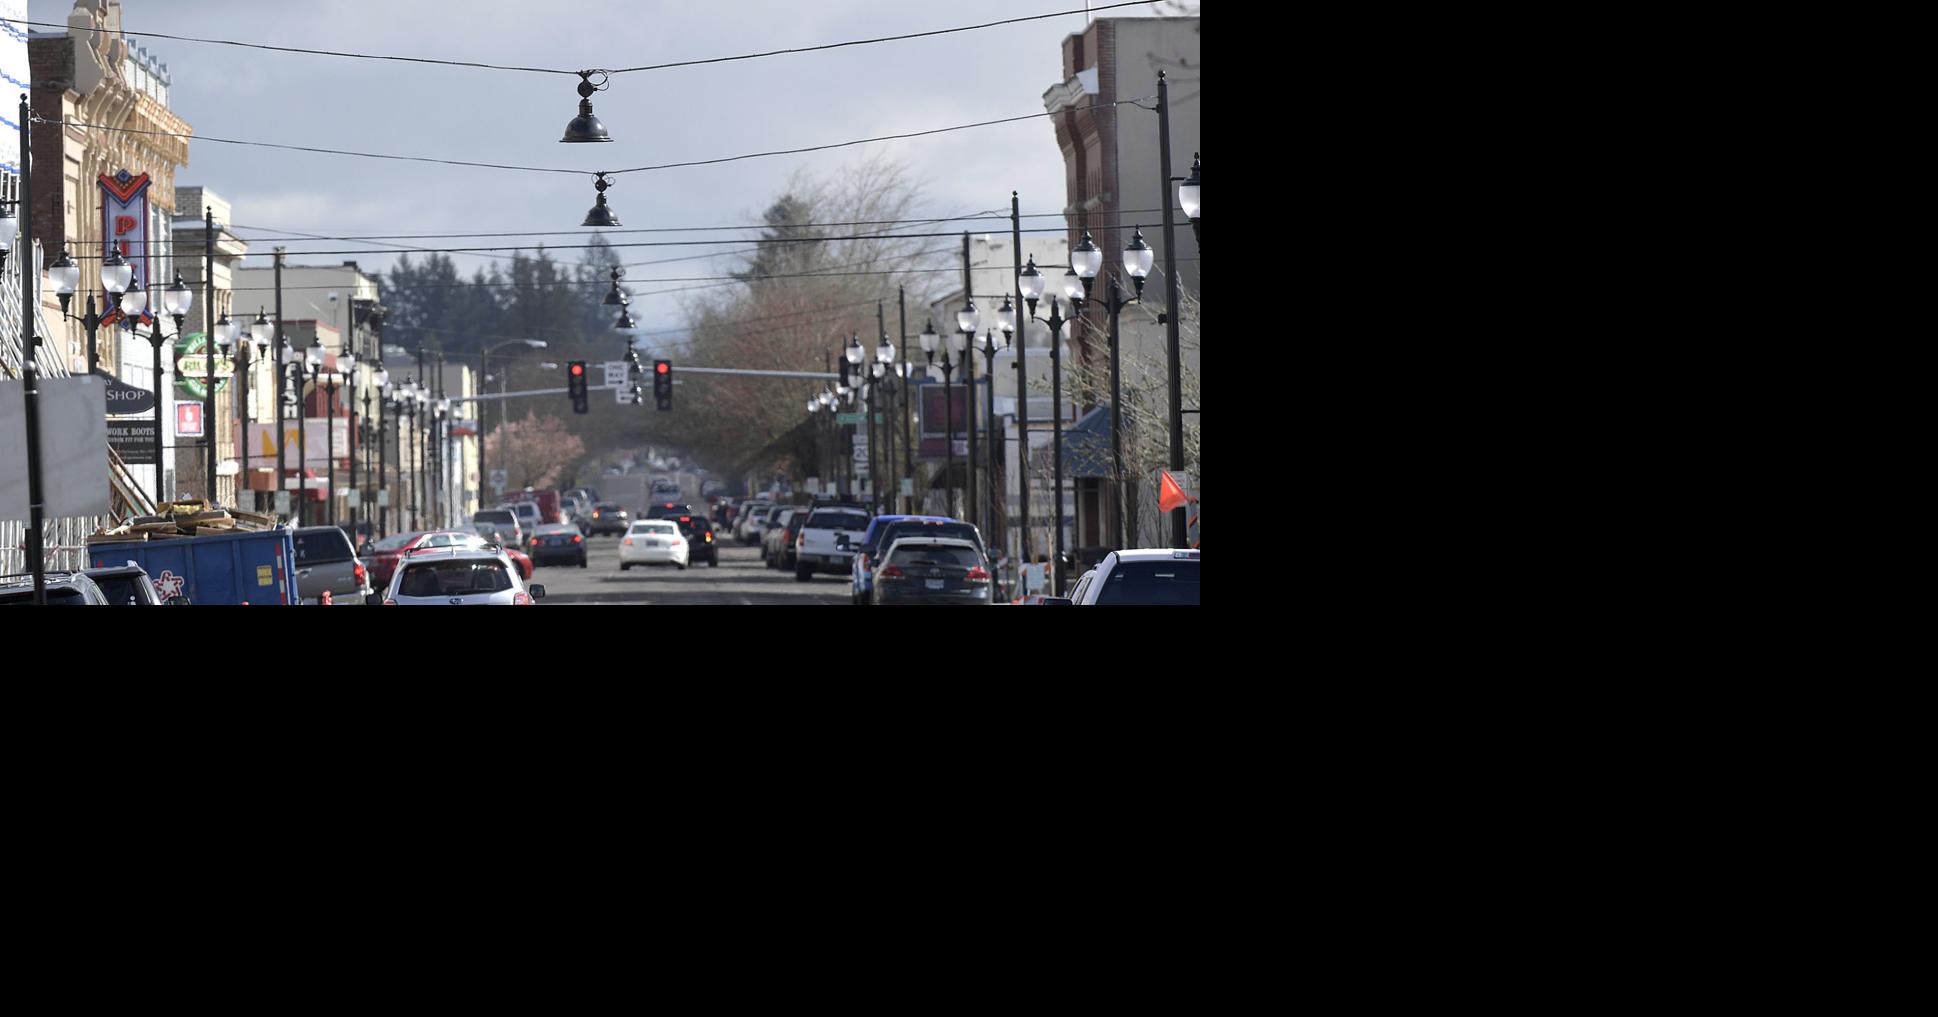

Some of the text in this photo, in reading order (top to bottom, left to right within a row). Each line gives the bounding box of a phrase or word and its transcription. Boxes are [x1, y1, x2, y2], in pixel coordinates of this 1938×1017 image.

[106, 389, 146, 401] SHOP
[284, 362, 298, 419] FISH
[131, 427, 156, 436] BOOTS
